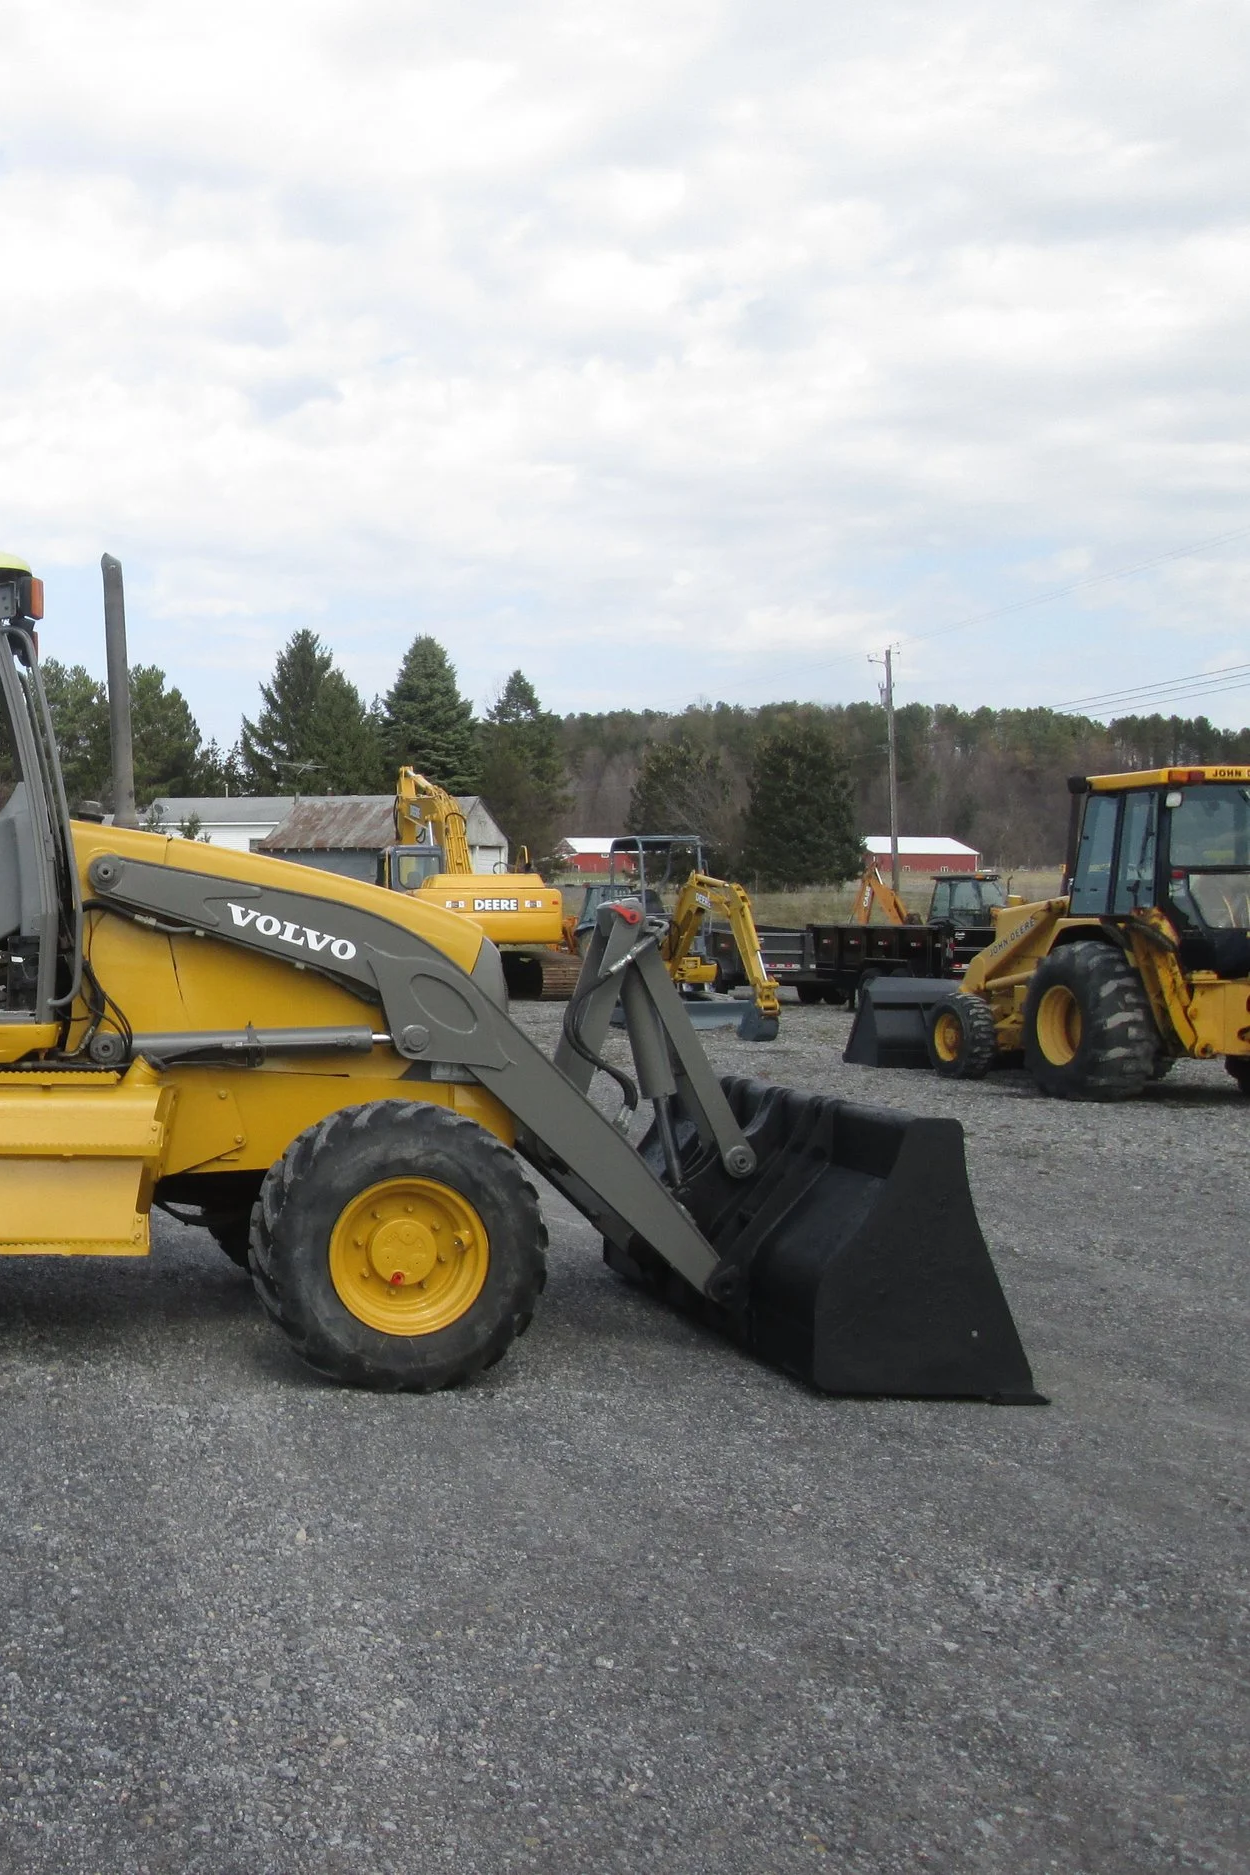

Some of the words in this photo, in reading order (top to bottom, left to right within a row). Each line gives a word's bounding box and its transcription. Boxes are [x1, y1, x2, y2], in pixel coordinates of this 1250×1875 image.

[1212, 768, 1242, 778] JOHN
[473, 899, 518, 911] DEERE
[226, 902, 357, 960] VOLVO
[989, 938, 1009, 958] JOHN
[1010, 918, 1035, 941] DEERE
